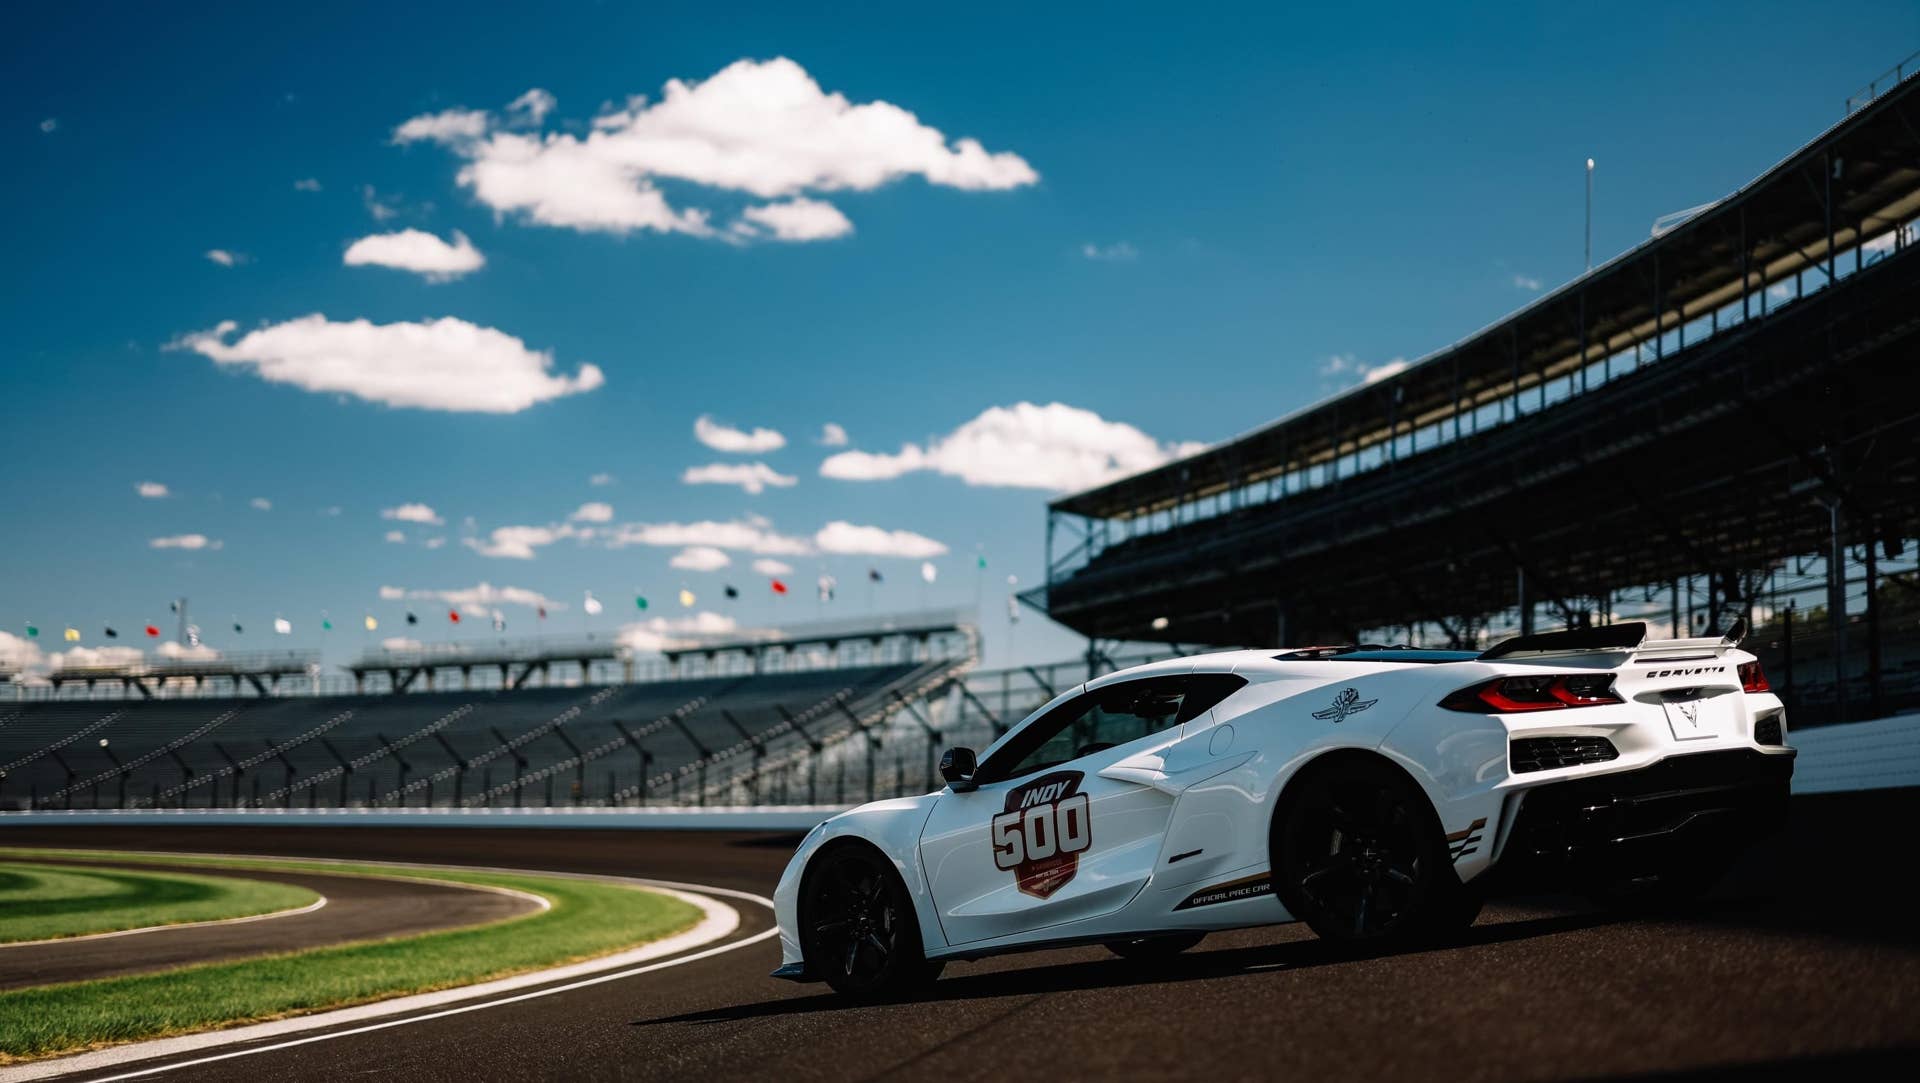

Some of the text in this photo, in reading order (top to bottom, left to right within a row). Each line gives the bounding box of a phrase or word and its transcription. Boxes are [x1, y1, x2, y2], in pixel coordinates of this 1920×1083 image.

[1646, 666, 1725, 678] CORVETTE
[1021, 779, 1071, 809] INDY
[993, 794, 1090, 868] 500
[1193, 883, 1270, 905] OFFICIAL PACE CAR
